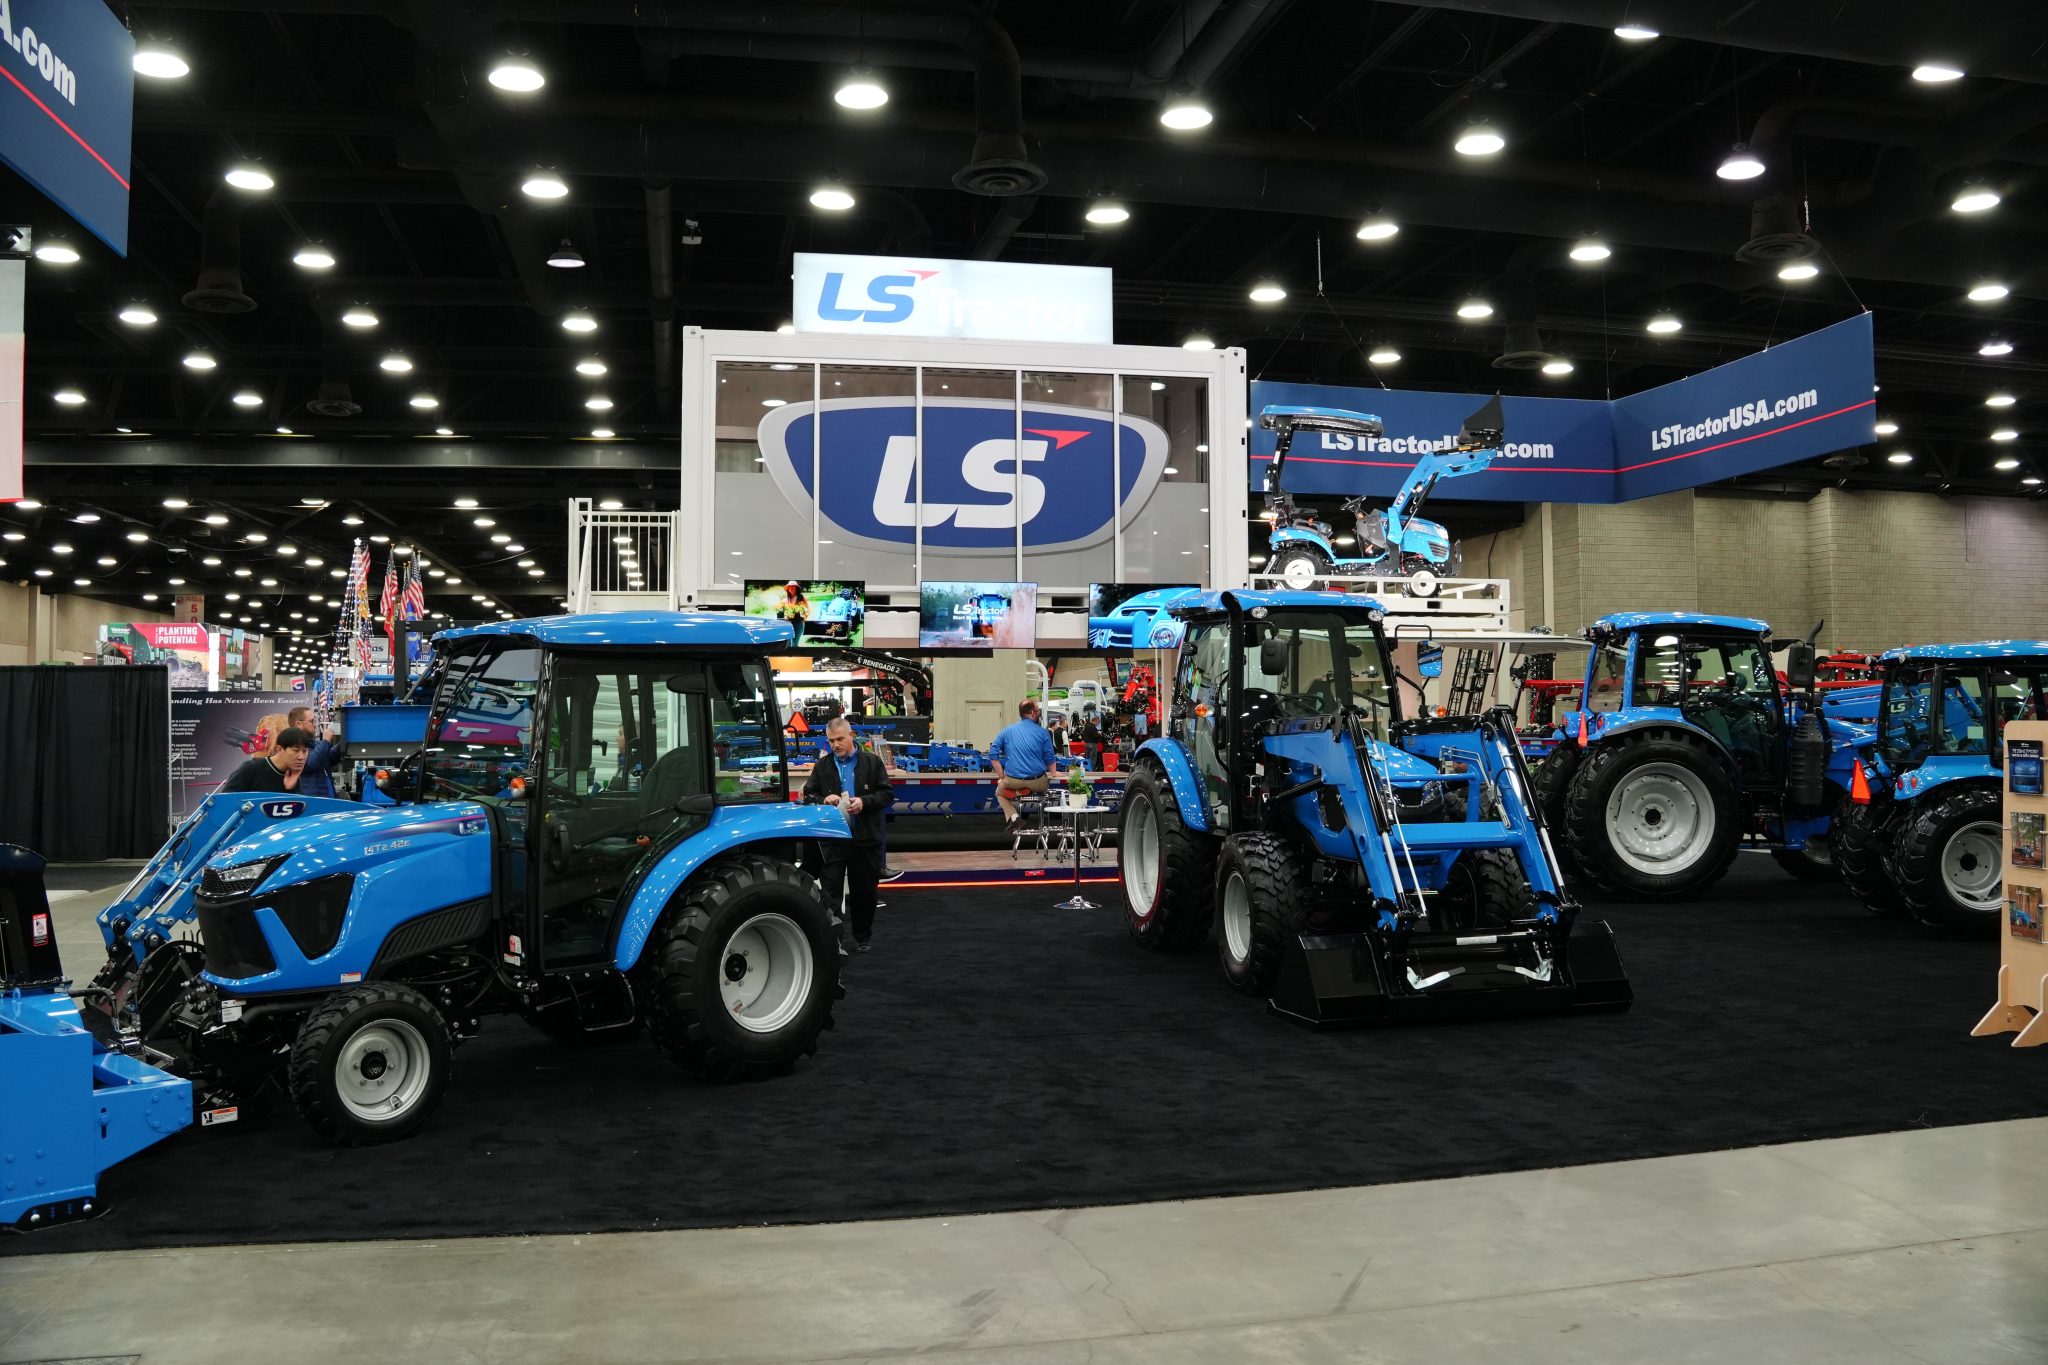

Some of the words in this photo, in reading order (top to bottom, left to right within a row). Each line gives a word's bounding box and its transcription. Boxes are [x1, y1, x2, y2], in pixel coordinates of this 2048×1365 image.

[817, 272, 916, 324] LS
[929, 287, 1095, 333] Tractor
[1651, 388, 1818, 451] LSTractorUSA.com
[872, 435, 1049, 529] LS
[953, 604, 972, 615] LS
[974, 606, 1004, 615] Tractor
[158, 626, 198, 636] PLANTING
[158, 635, 198, 644] POTENTIAL
[862, 658, 896, 672] RENEGADE
[1890, 702, 1906, 713] LS
[272, 804, 293, 817] LS
[458, 821, 479, 834] LS
